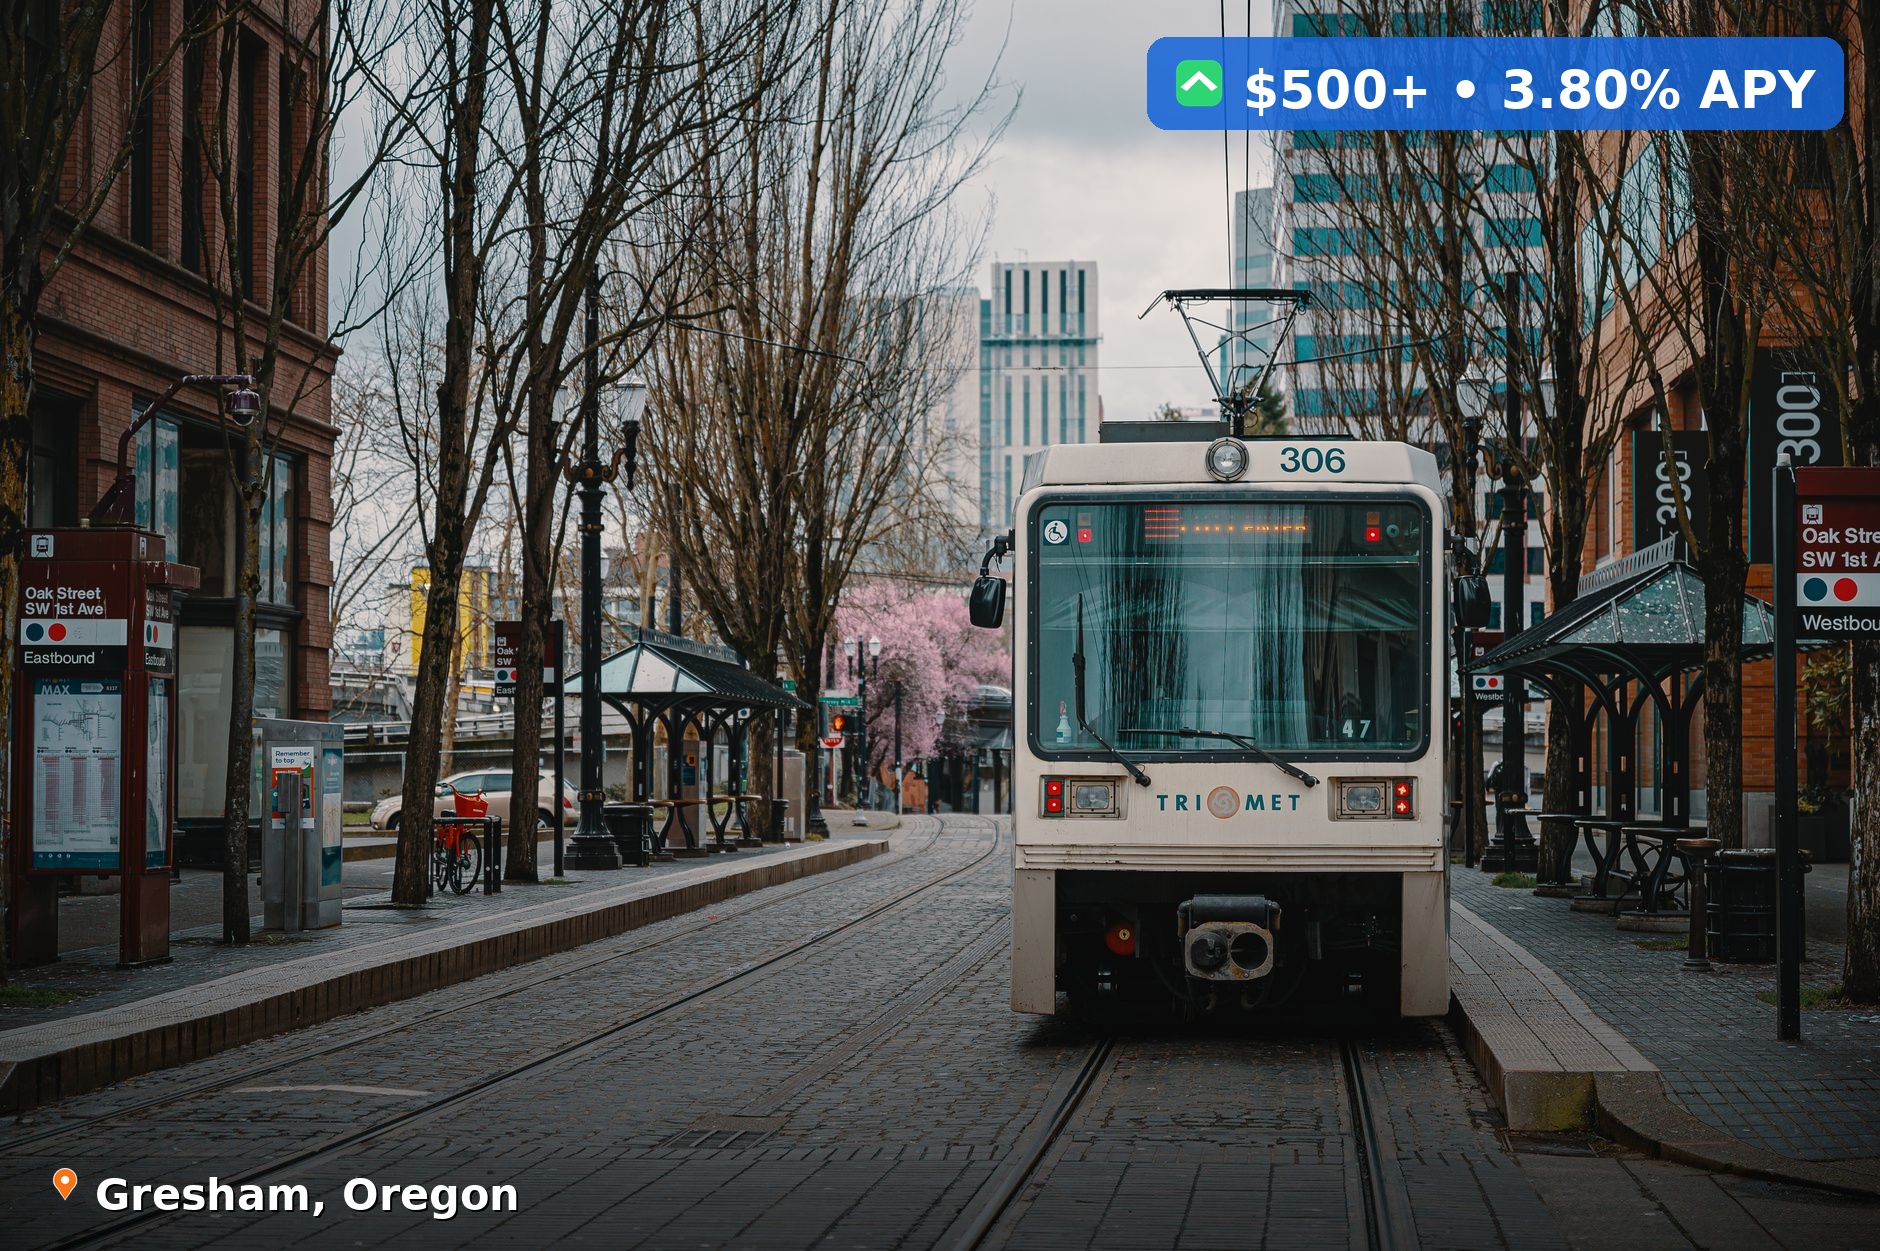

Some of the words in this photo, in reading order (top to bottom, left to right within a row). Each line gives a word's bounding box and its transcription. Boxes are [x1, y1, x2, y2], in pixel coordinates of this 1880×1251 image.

[1280, 447, 1346, 474] 306
[1802, 527, 1841, 544] Oak
[1802, 550, 1836, 567] SW
[1841, 551, 1868, 567] 1st
[25, 586, 54, 600] Oak
[57, 586, 101, 600] Street
[25, 602, 51, 616] SW
[54, 602, 74, 616] 1st
[77, 602, 104, 616] Ave
[145, 604, 155, 618] SW
[24, 651, 95, 665] Eastbound
[496, 647, 514, 656] Oak
[145, 652, 166, 667] Eastbound
[496, 658, 512, 666] SW
[41, 684, 71, 696] MAX
[1156, 794, 1201, 812] TRI
[1245, 794, 1300, 812] MET
